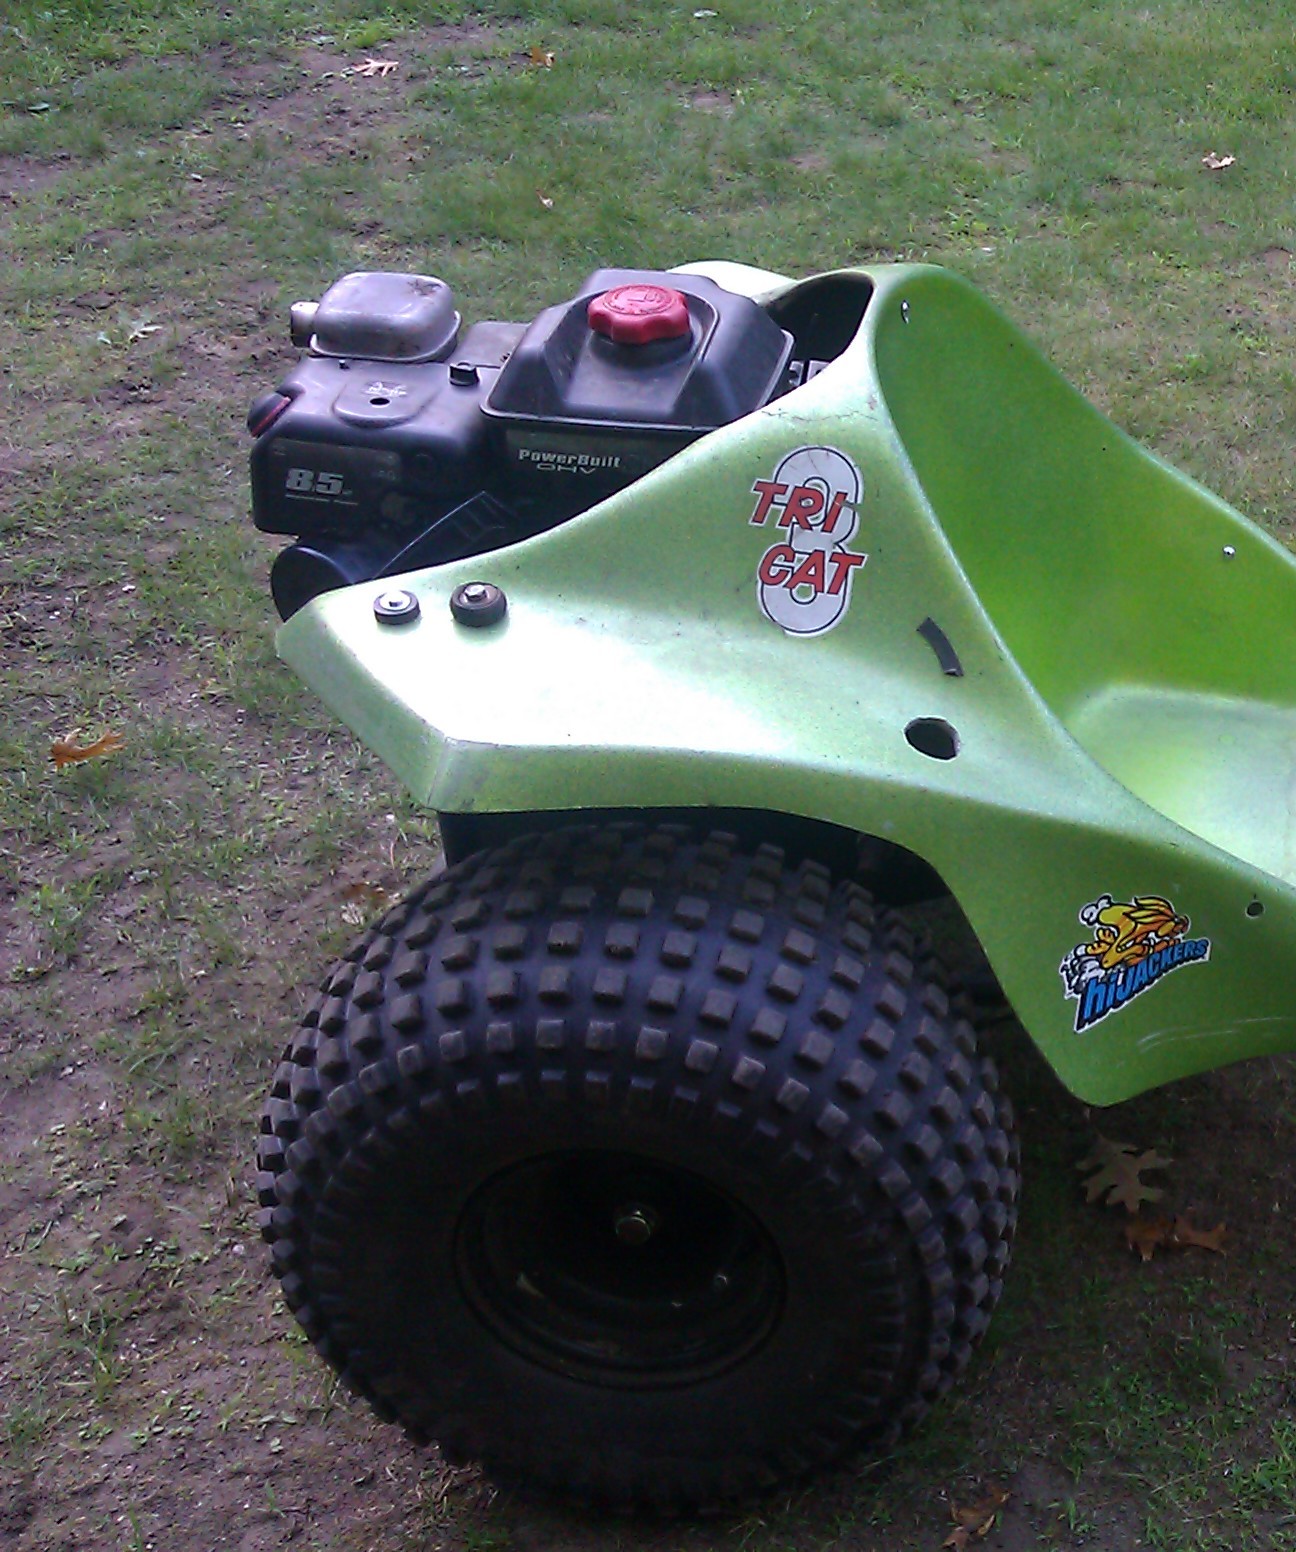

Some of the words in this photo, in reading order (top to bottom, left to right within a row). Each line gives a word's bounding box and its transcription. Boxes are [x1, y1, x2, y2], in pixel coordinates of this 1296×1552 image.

[519, 448, 621, 468] PowerBuilt
[536, 463, 596, 474] OHV
[752, 480, 849, 533] TRI
[759, 544, 866, 595] CAT
